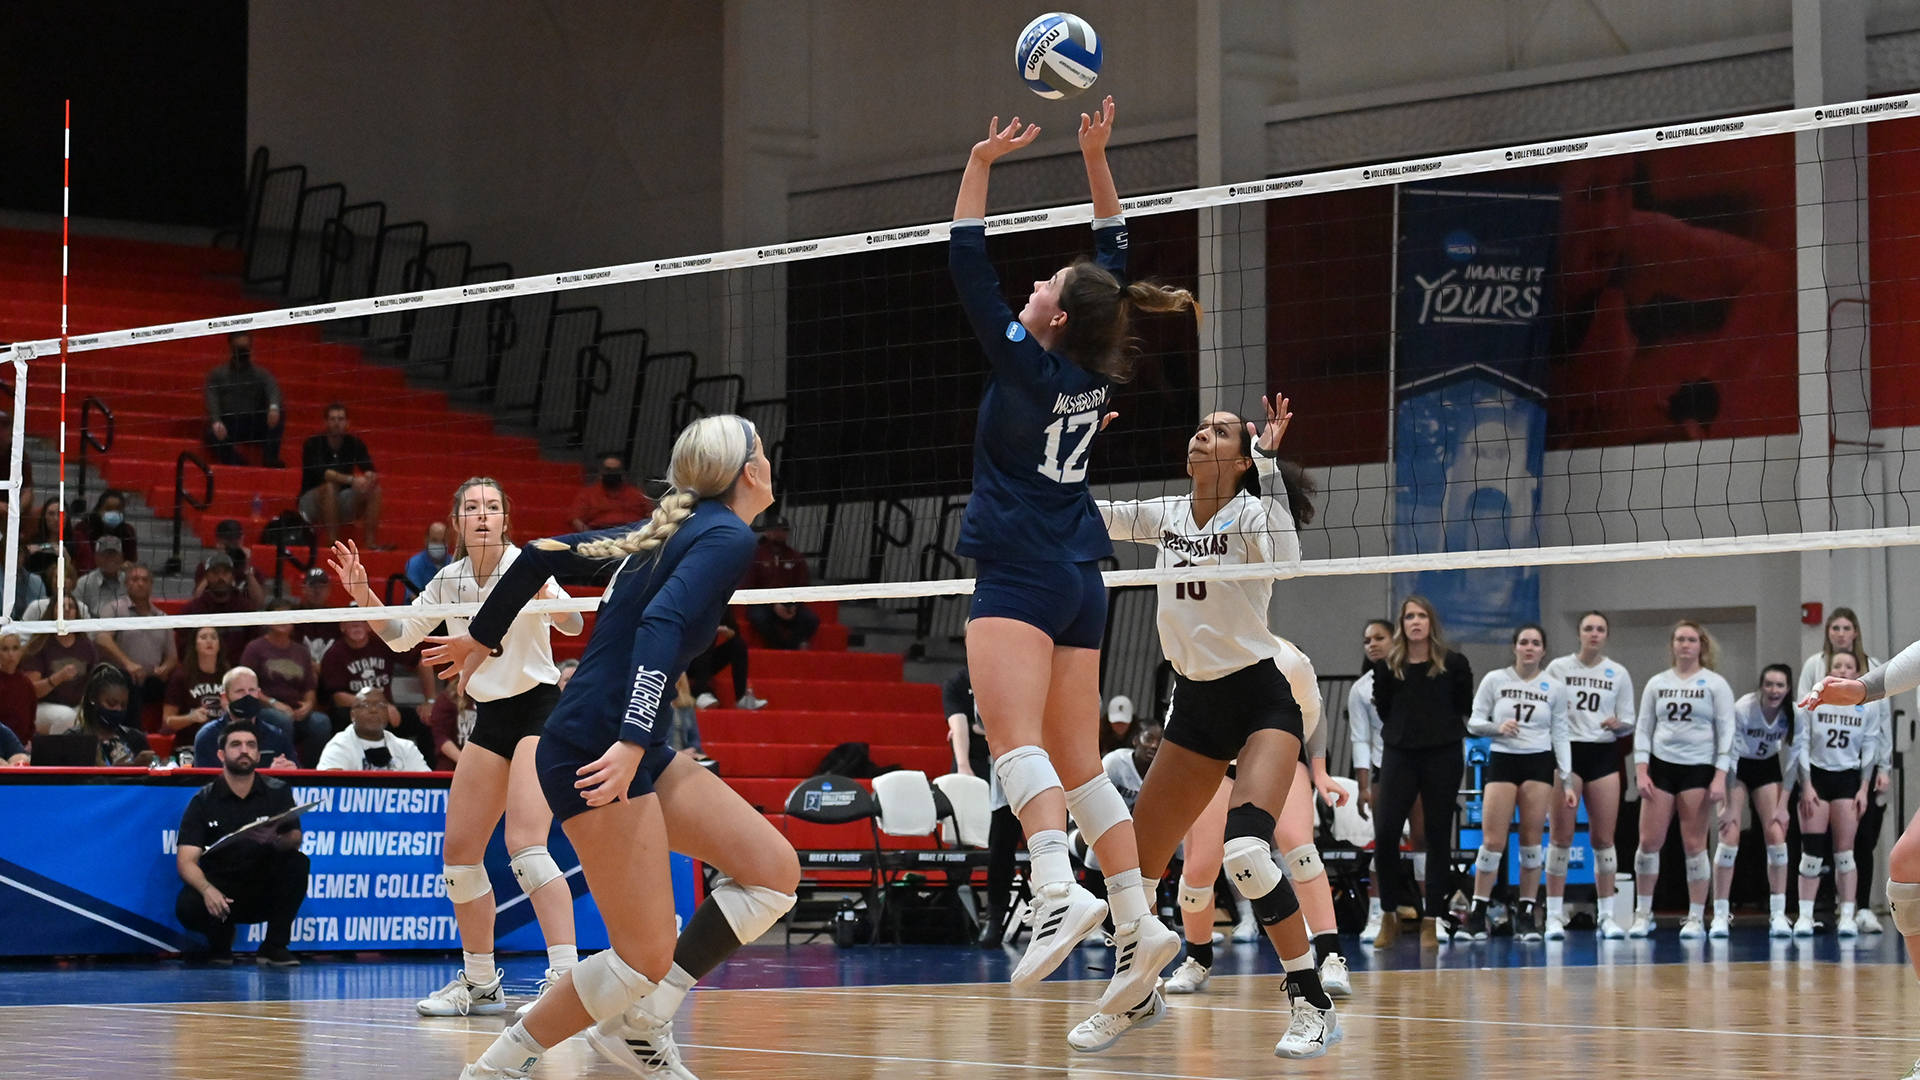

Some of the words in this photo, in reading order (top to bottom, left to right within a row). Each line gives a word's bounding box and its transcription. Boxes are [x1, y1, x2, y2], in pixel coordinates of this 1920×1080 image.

[1027, 29, 1060, 71] molten
[1824, 107, 1860, 118] VOLLEYBALL
[1861, 100, 1908, 114] CHAMPIONSHIP
[1664, 128, 1698, 139] VOLLEYBALL
[1699, 122, 1744, 135] CHAMPIONSHIP
[1513, 148, 1545, 159] VOLLEYBALL
[1546, 142, 1588, 155] CHAMPIONSHIP
[1371, 167, 1402, 178] VOLLEYBALL
[1402, 162, 1441, 174] CHAMPIONSHIP
[1236, 183, 1264, 195] VOLLEYBALL
[1265, 180, 1303, 191] CHAMPIONSHIP
[1136, 197, 1173, 208] CHAMPIONSHIP
[988, 217, 1014, 228] VOLLEYBALL
[1014, 214, 1048, 224] CHAMPIONSHIP
[873, 233, 898, 242] VOLLEYBALL
[898, 229, 930, 239] CHAMPIONSHIP
[763, 248, 787, 257] VOLLEYBALL
[787, 244, 818, 254] CHAMPIONSHIP
[660, 262, 682, 270] VOLLEYBALL
[683, 258, 711, 267] CHAMPIONSHIP
[1464, 265, 1522, 281] MAKE
[1525, 267, 1545, 282] IT
[1415, 269, 1542, 324] YOURS
[1052, 384, 1108, 414] WASHBURN
[1037, 410, 1099, 484] 12
[1190, 534, 1228, 557] TEXAS
[1565, 676, 1587, 686] WEST
[1589, 678, 1613, 691] TEXAS
[624, 665, 667, 733] ICHABODS
[1501, 689, 1522, 698] WEST
[1576, 691, 1600, 713] 20
[1658, 689, 1678, 698] WEST
[1680, 689, 1705, 699] TEXAS
[1513, 703, 1536, 723] 17
[1666, 702, 1692, 722] 22
[1817, 713, 1837, 724] WEST
[1840, 715, 1862, 727] TEXAS
[1826, 729, 1850, 748] 25
[1756, 742, 1769, 757] 5
[299, 831, 335, 855] &M
[340, 831, 444, 855] UNIVERSIT
[375, 874, 447, 898] COLLEG
[345, 916, 458, 941] UNIVERSITY
